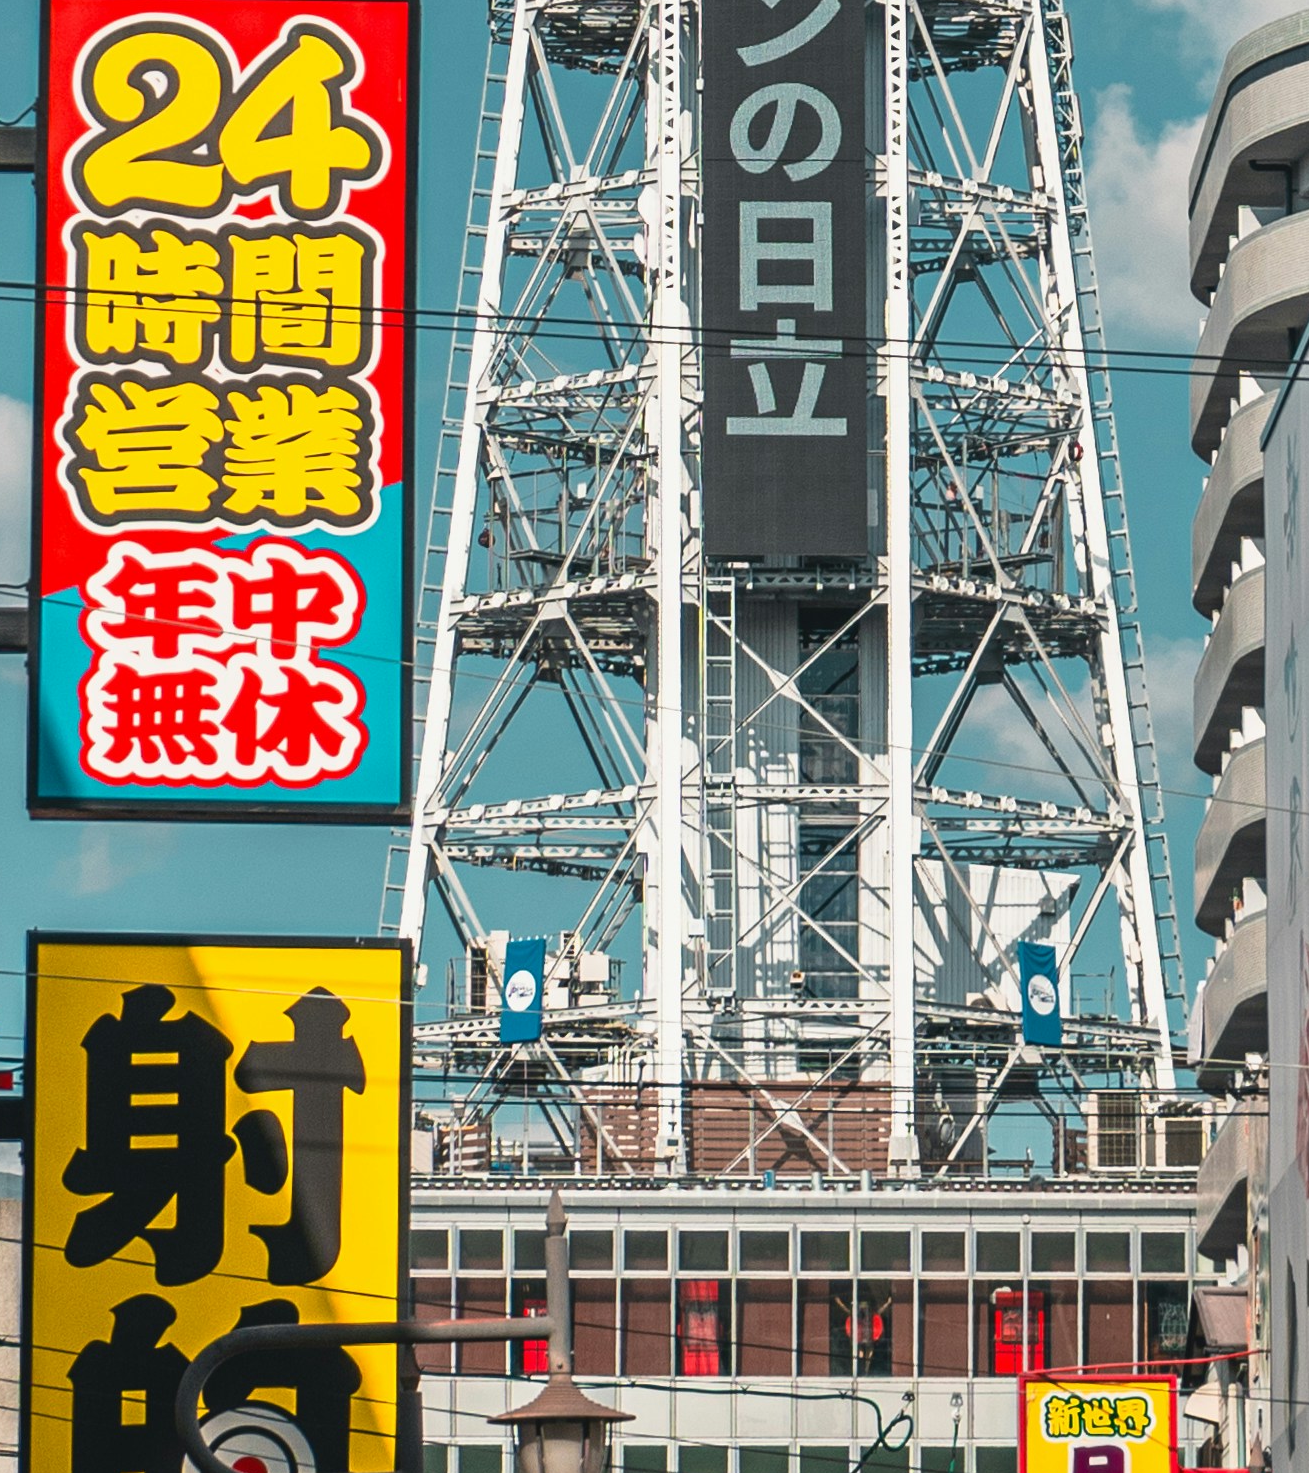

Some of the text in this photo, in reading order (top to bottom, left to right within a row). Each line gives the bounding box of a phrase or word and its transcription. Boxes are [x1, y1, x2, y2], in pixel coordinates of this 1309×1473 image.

[82, 29, 373, 213] 24
[83, 231, 366, 367] 時間
[76, 381, 362, 517] 営業
[96, 548, 354, 665] 年中
[96, 665, 348, 769] 無休
[1046, 1397, 1152, 1437] 新世界
